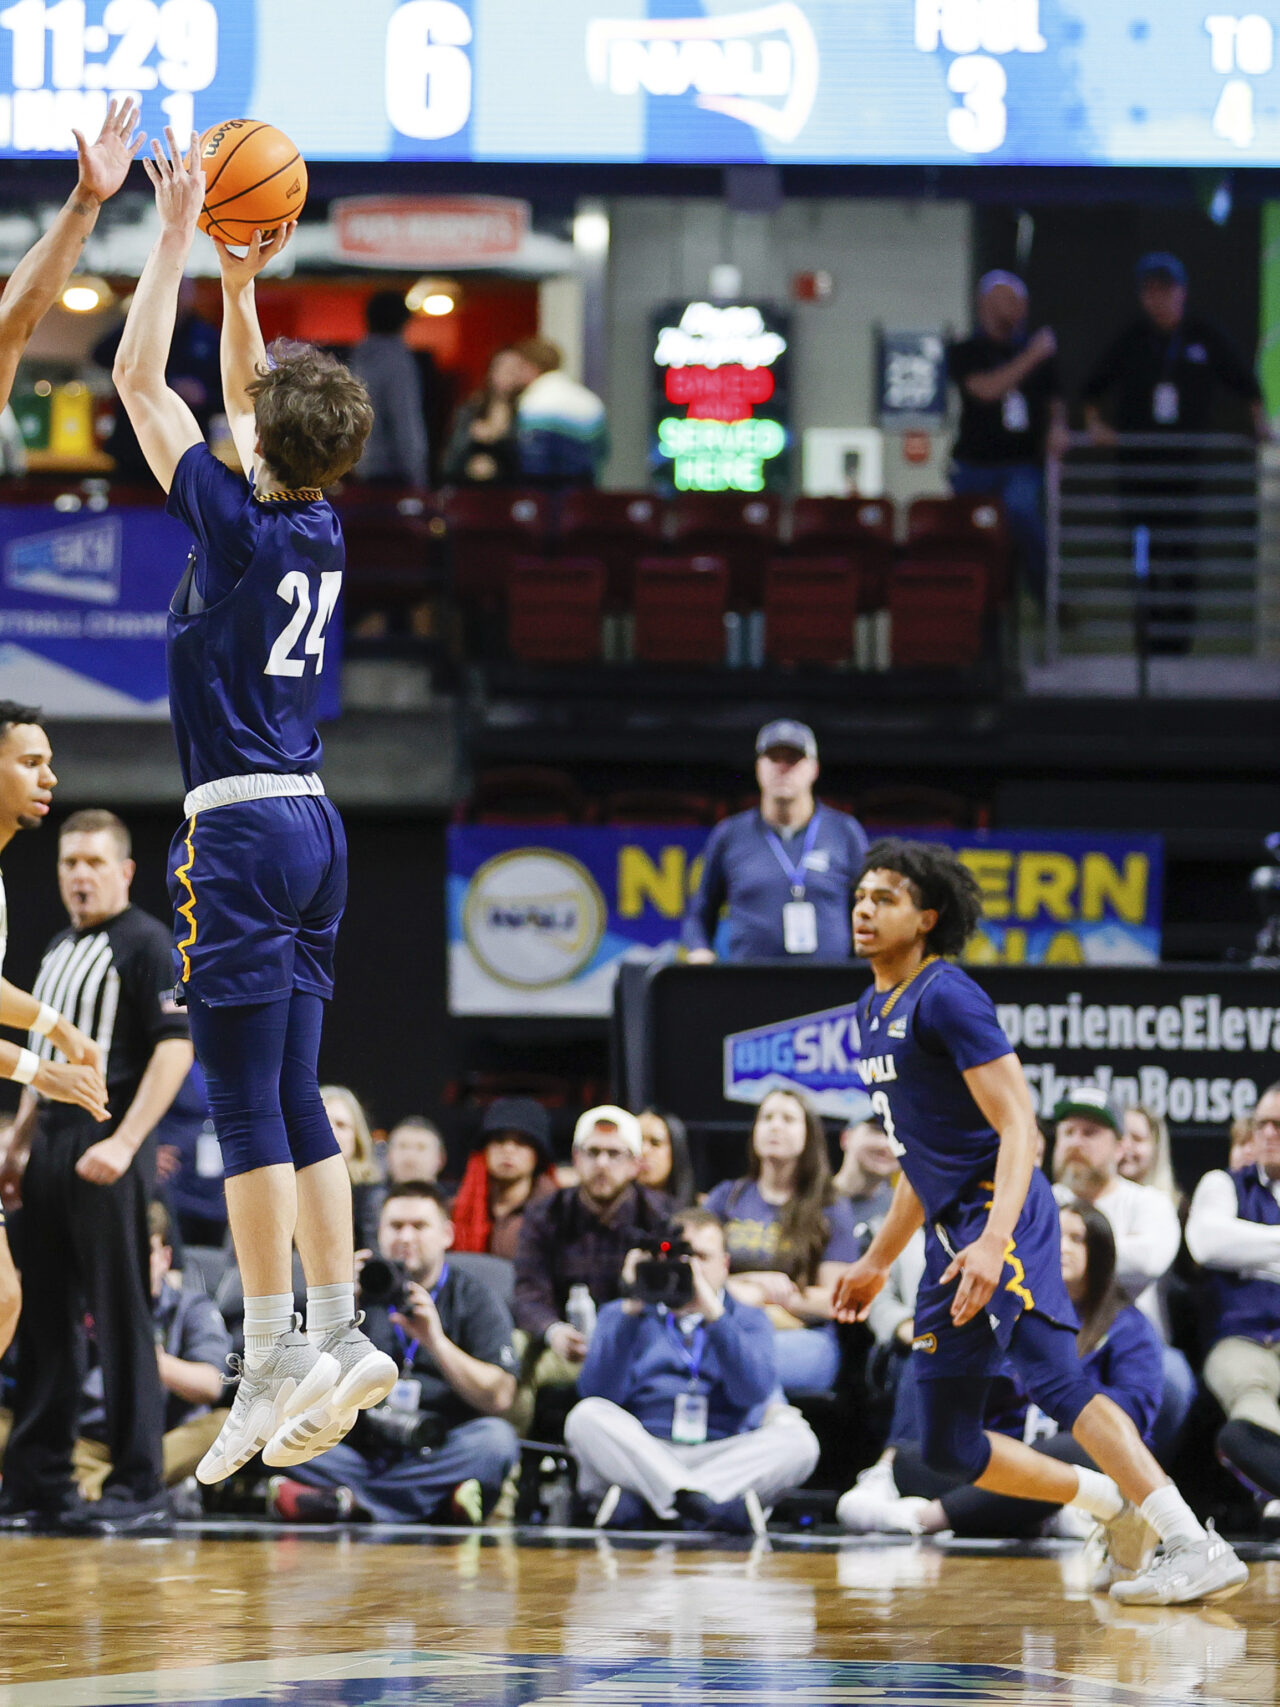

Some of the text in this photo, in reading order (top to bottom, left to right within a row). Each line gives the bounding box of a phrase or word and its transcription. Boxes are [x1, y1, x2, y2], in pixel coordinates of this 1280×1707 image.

[386, 0, 472, 140] 6
[1206, 15, 1272, 73] TO
[947, 55, 1007, 153] 3
[1214, 80, 1255, 149] 4
[263, 570, 342, 677] 24
